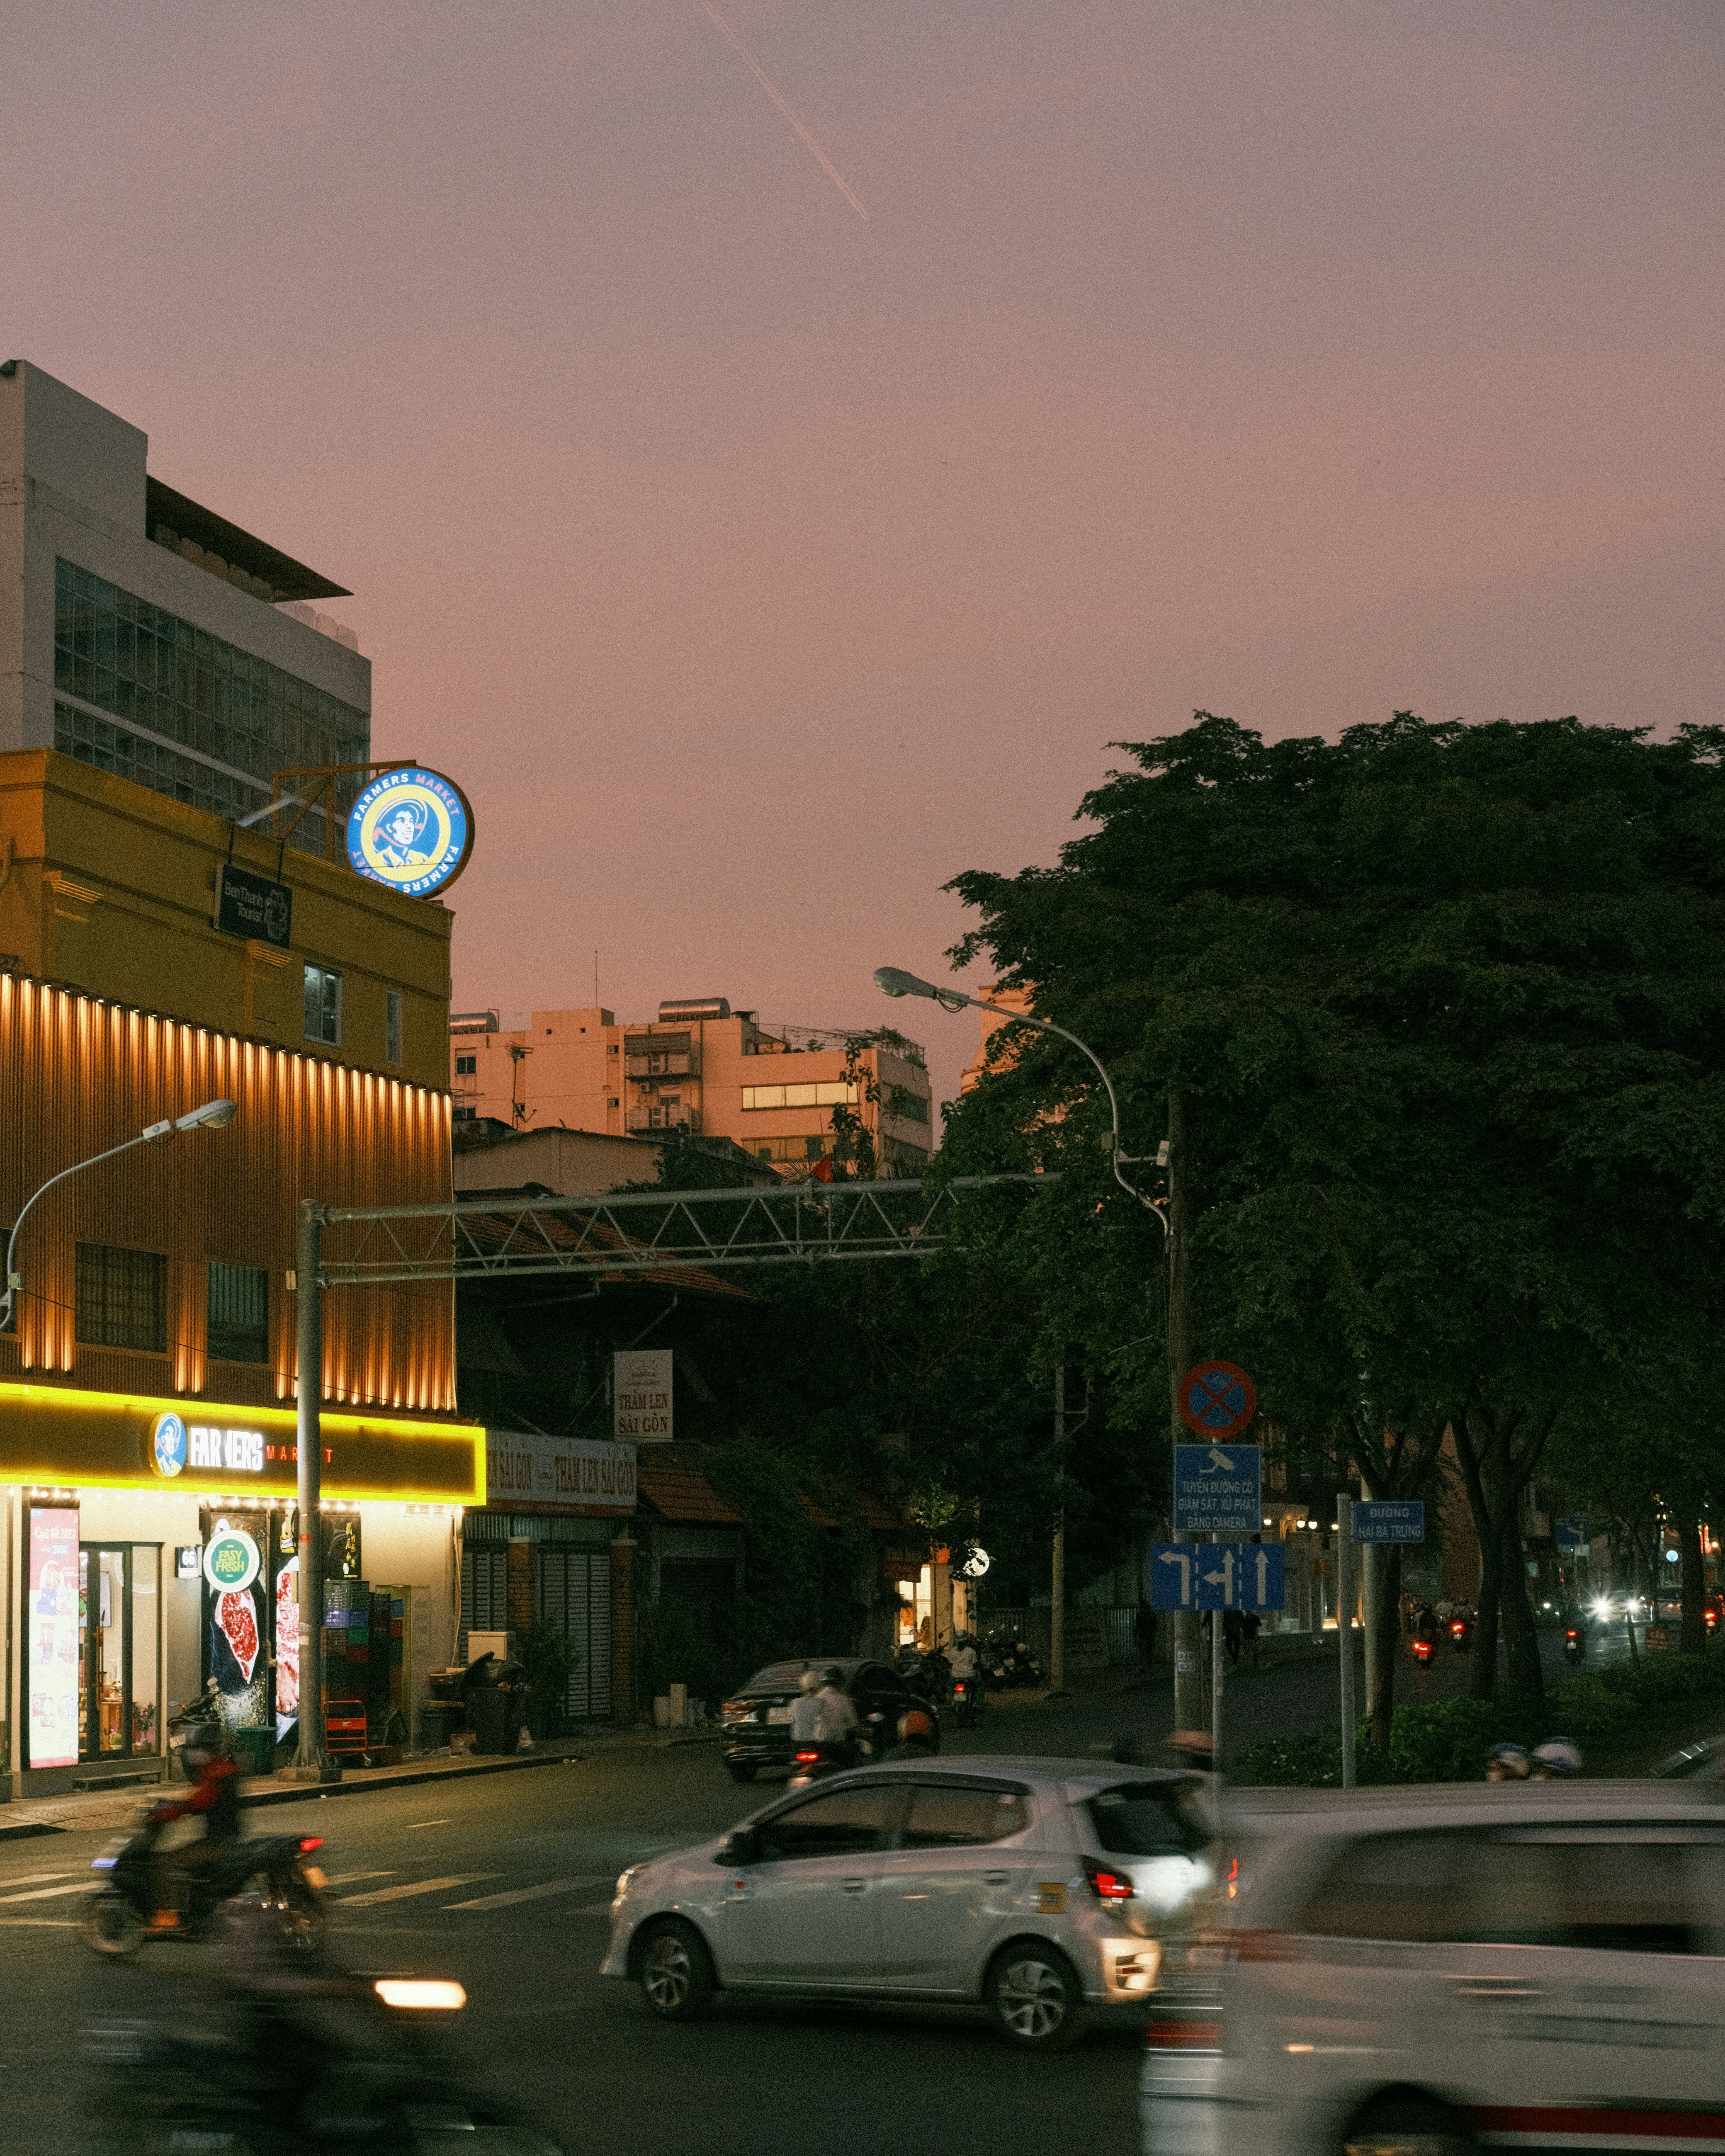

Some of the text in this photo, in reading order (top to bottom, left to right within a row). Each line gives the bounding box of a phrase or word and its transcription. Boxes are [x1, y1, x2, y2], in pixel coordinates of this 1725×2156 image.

[354, 773, 459, 821] FARMERS MARKET
[403, 846, 459, 893] FARMERS
[236, 902, 262, 923] Tourist
[650, 1394, 668, 1409] LEN
[618, 1413, 668, 1433] SÀI GÒN
[265, 1445, 332, 1463] MART
[1182, 1477, 1253, 1493] TUYẾN ĐƯỜNG CÓ
[1178, 1495, 1199, 1510] GIÁM
[1187, 1511, 1246, 1529] BẰNG CAMERA
[60, 1528, 76, 1539] 2023
[1358, 1525, 1374, 1538] HAI
[1376, 1522, 1388, 1538] BÀ
[182, 1551, 195, 1566] 66
[219, 1550, 243, 1561] EASY
[216, 1561, 245, 1572] FRESH
